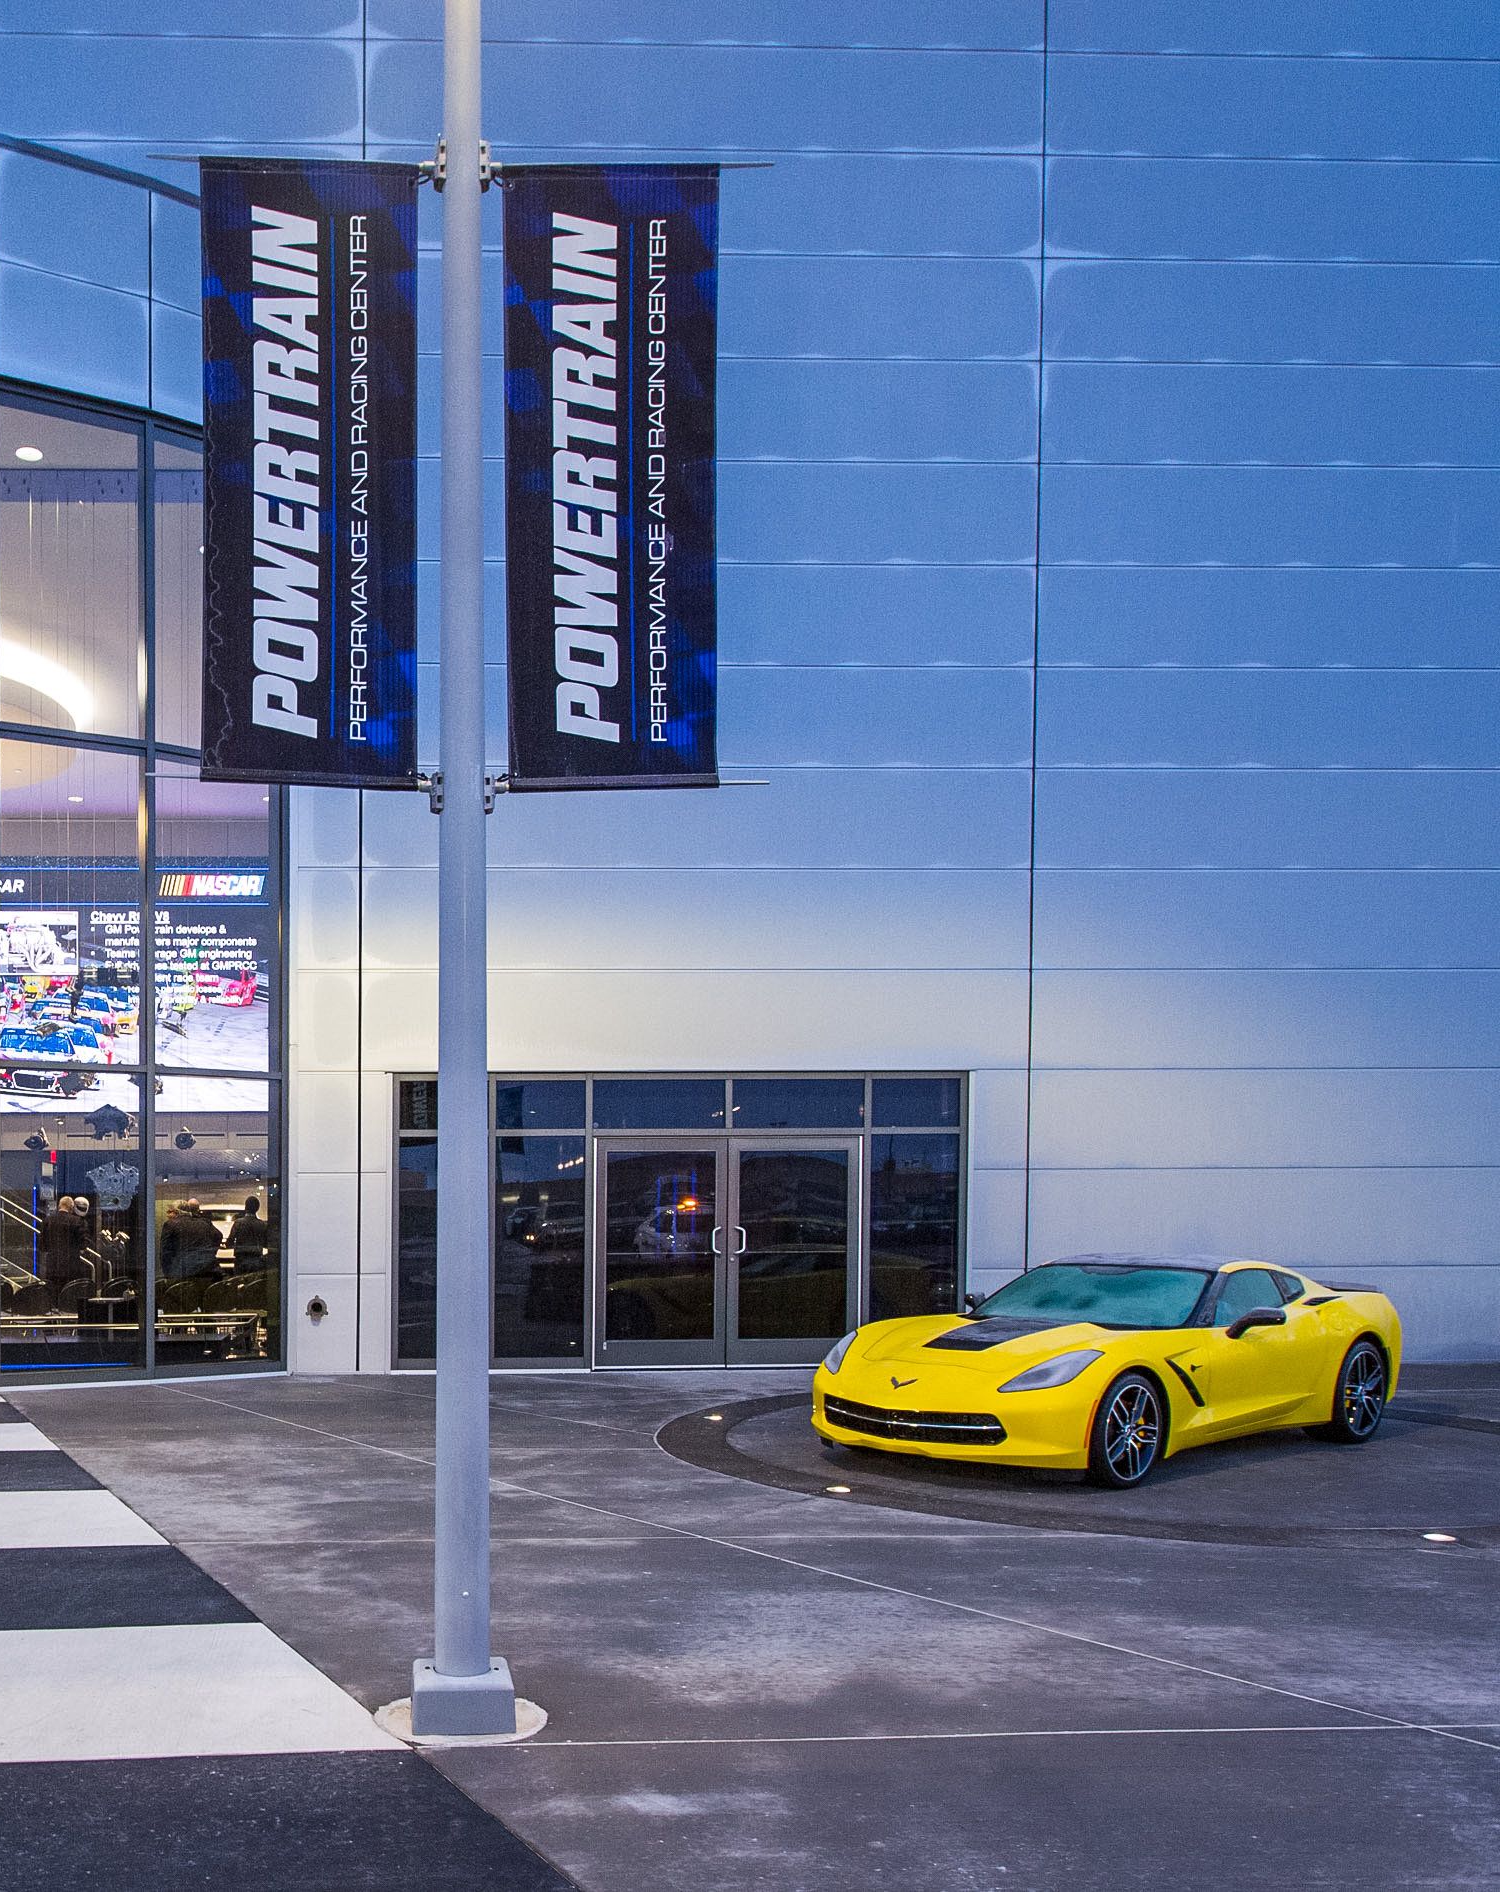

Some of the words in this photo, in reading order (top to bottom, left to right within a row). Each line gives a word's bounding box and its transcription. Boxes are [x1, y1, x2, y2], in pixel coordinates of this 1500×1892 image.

[350, 215, 367, 330] CENTER
[648, 219, 666, 334] CENTER
[351, 336, 367, 444] RACING
[648, 340, 666, 448] RACING
[251, 205, 319, 738] POWERTRAIN
[351, 450, 368, 515] AND
[553, 212, 620, 743] POWERTRAIN
[648, 454, 666, 519] AND
[350, 520, 367, 741] PERFORMANCE
[648, 524, 667, 742] PERFORMANCE
[90, 911, 126, 924] Chevy
[105, 925, 122, 934] GM
[175, 924, 217, 936] develops
[219, 924, 227, 934] &
[191, 875, 264, 896] NASCAR
[105, 948, 136, 958] Teams
[180, 949, 197, 958] GM
[198, 949, 253, 960] engineering
[172, 937, 199, 948] major
[201, 937, 258, 948] components
